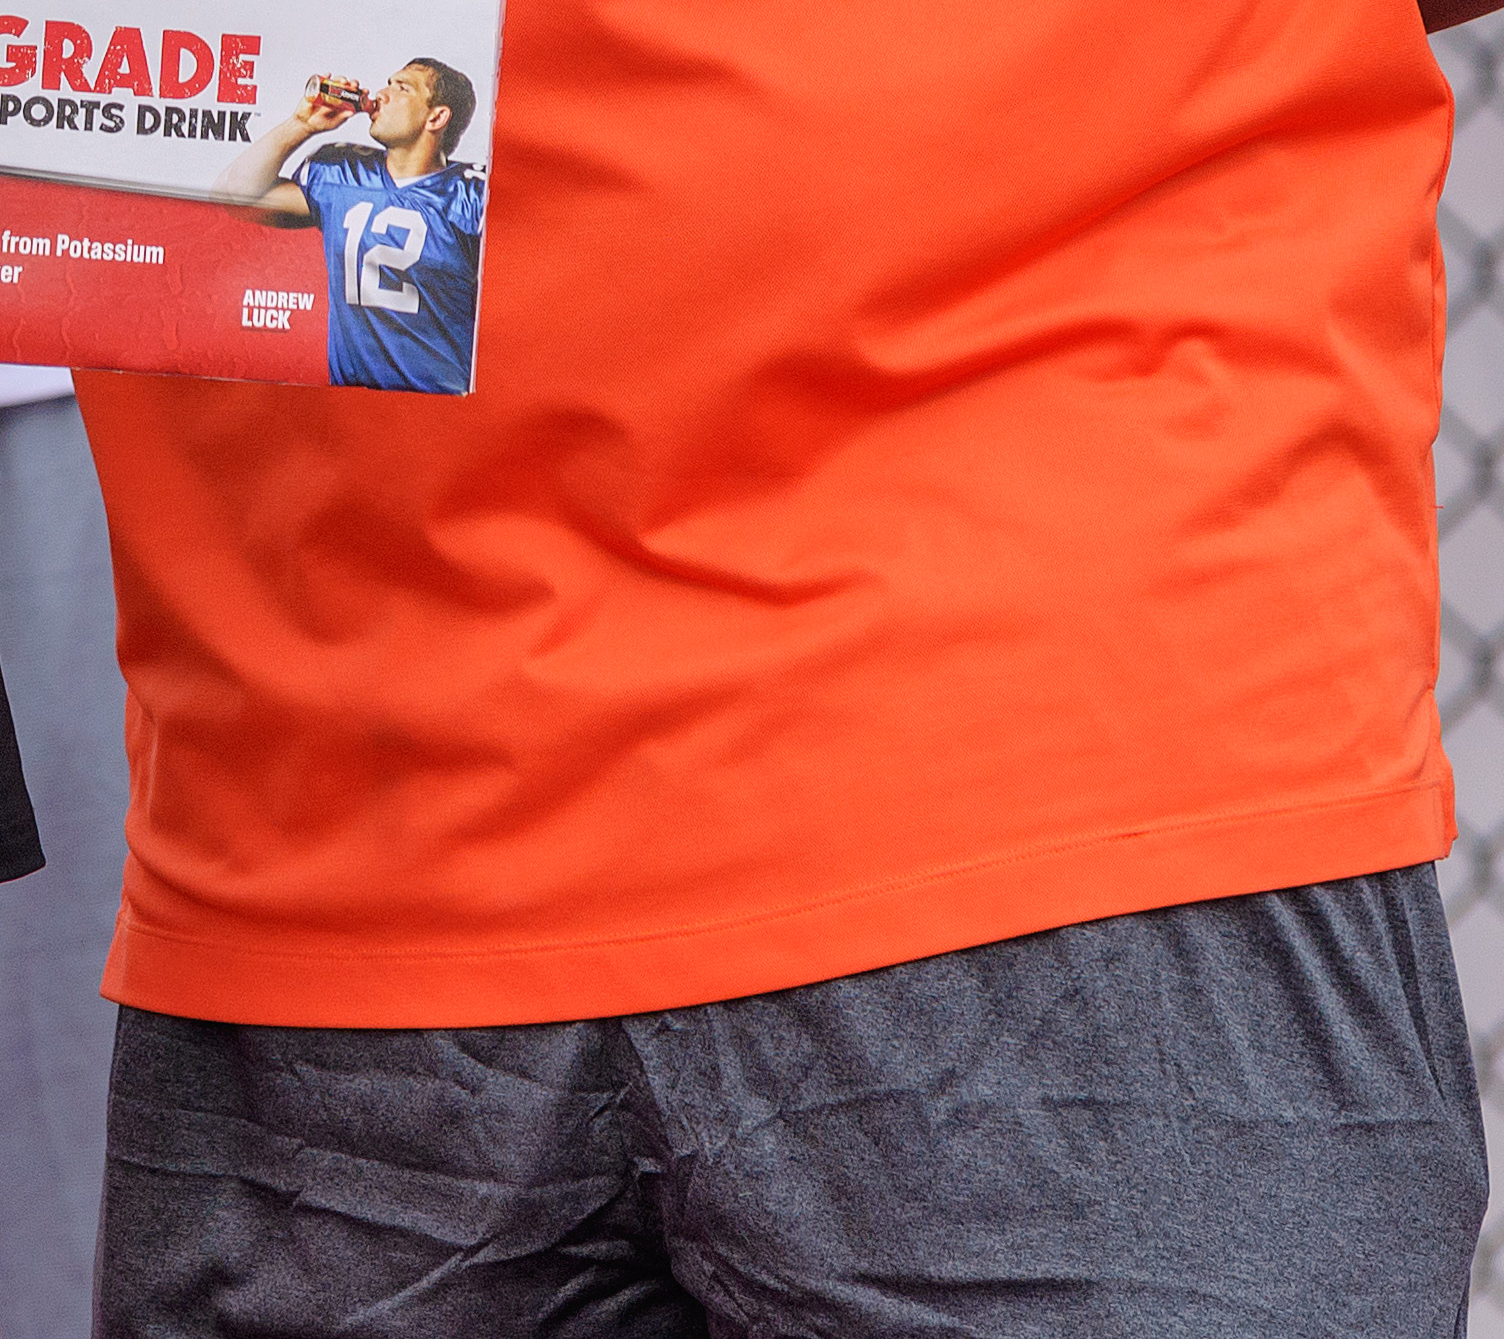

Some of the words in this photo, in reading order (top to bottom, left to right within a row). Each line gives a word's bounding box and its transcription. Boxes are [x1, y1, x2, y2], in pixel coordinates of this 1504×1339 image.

[135, 104, 252, 143] DRINK
[1, 230, 51, 257] from
[55, 233, 165, 265] Potassium
[343, 201, 428, 315] 12
[242, 289, 314, 311] ANDREW
[242, 308, 291, 330] LUCK
